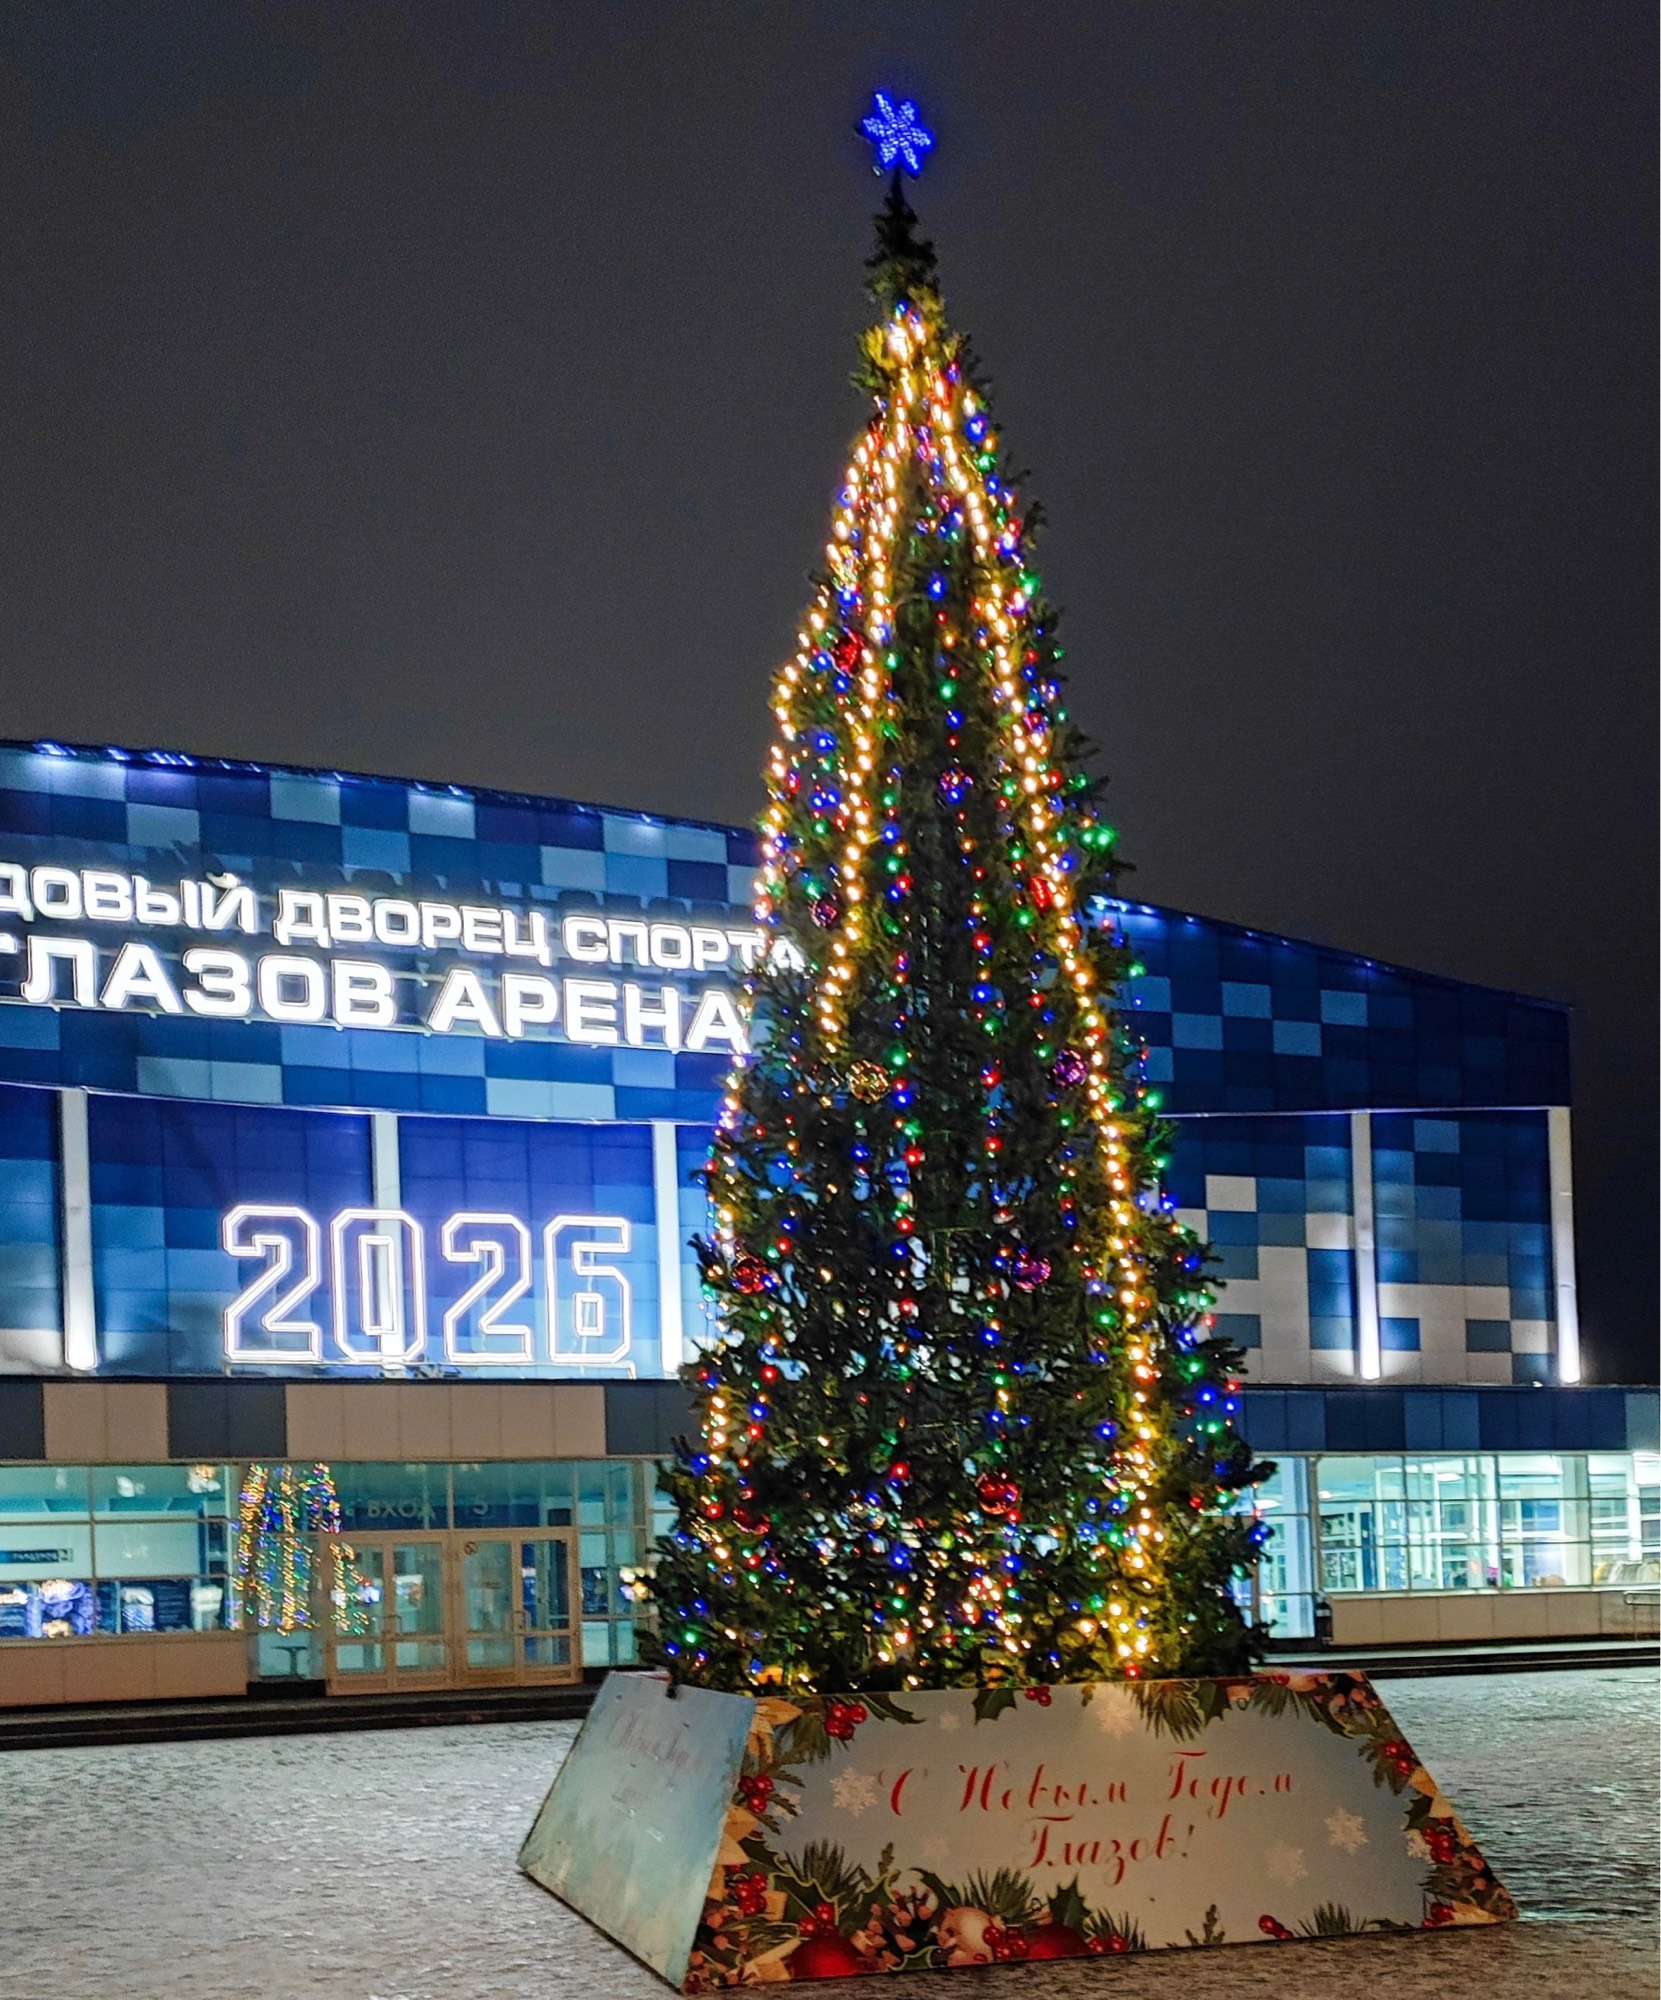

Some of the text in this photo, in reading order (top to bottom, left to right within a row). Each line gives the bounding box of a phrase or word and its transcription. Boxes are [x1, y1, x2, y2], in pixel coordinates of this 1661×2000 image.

[274, 888, 552, 966] ДВОРЕЦ
[562, 915, 808, 977] СПОРТА
[427, 968, 752, 1054] АРЕНА
[222, 1205, 632, 1364] 2026
[878, 1751, 1291, 1819] С Новым Годом
[1025, 1813, 1195, 1887] Глазов!
